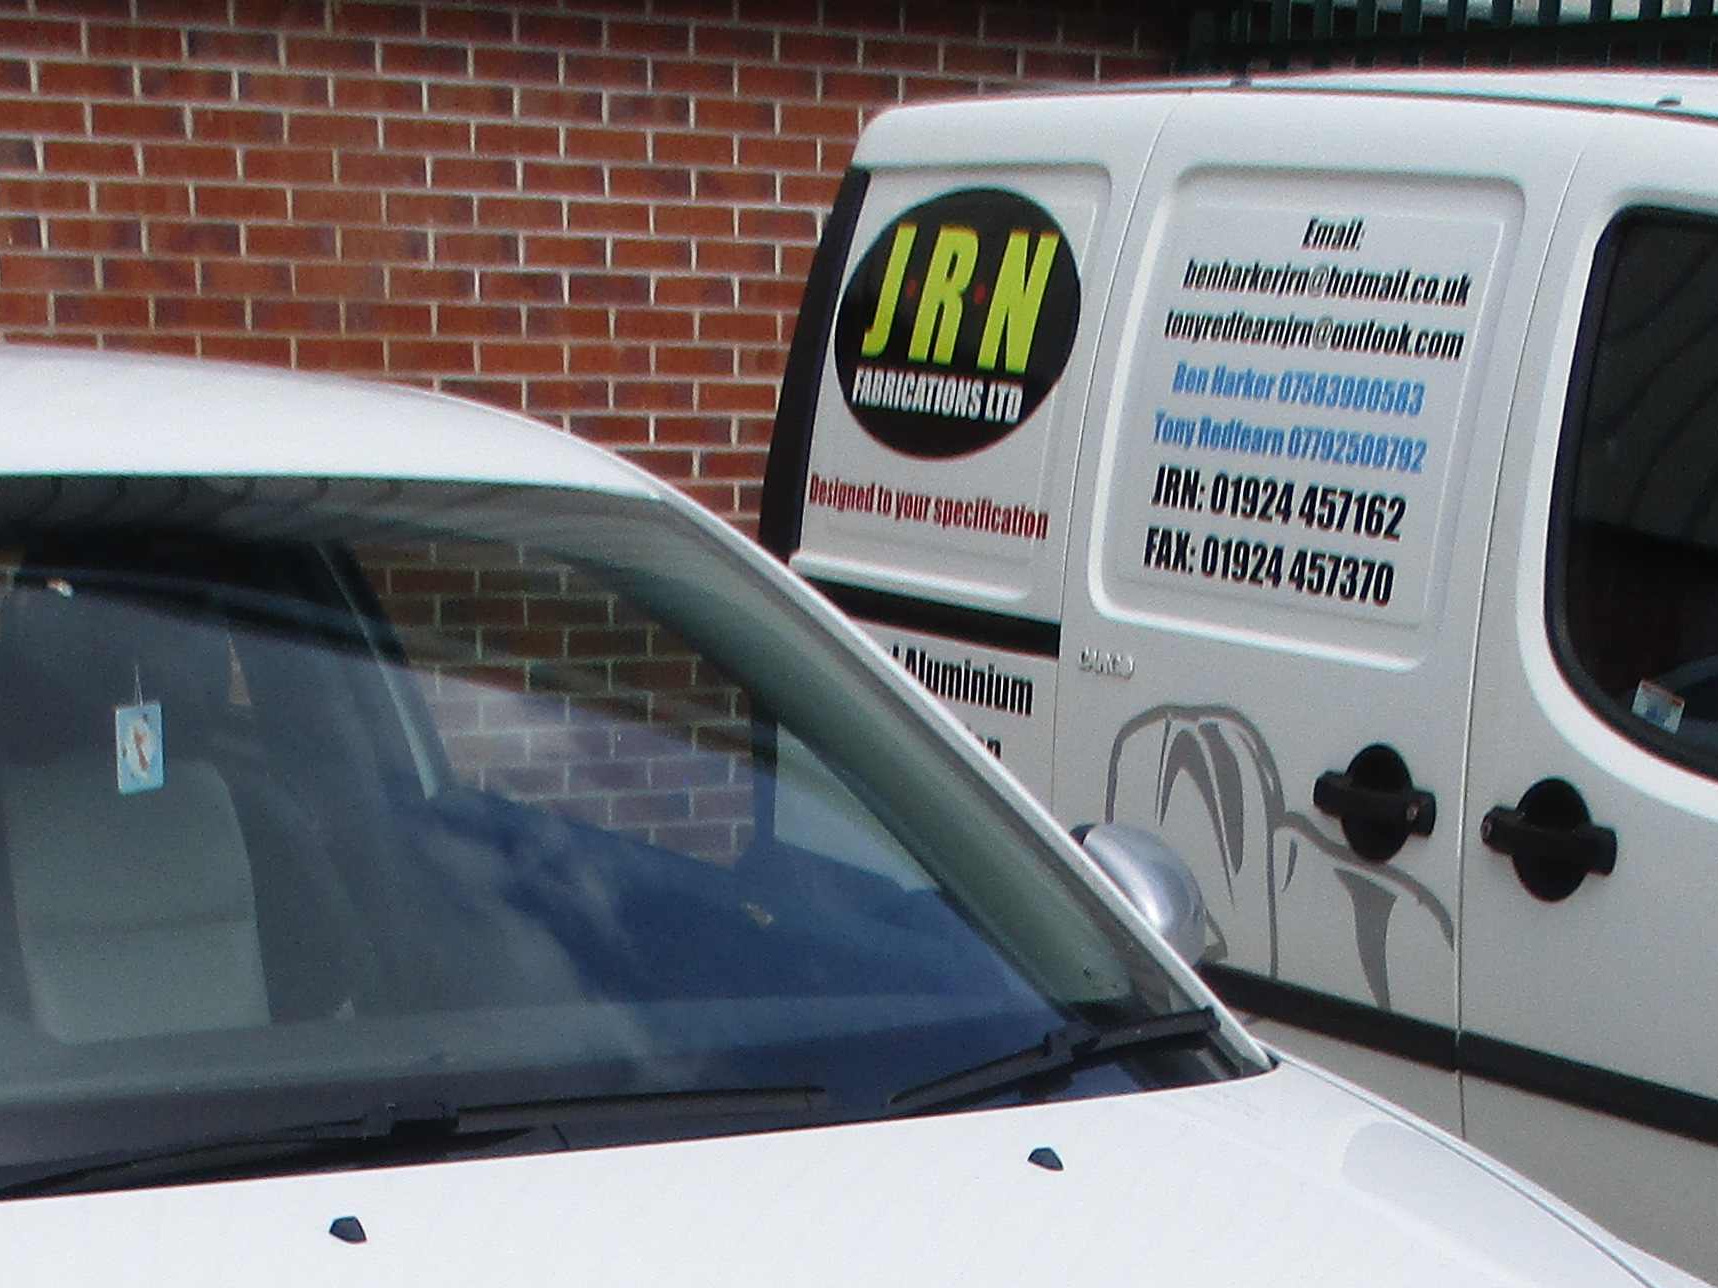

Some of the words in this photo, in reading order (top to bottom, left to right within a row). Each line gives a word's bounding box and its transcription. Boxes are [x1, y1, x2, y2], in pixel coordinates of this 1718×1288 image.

[1301, 216, 1366, 250] Email:
[1183, 258, 1471, 307] benharkerjrn@hotmail.co.uk
[1164, 309, 1465, 361] tonyredfearnjrn@outlook.com
[852, 365, 984, 420] FABRICATIONS
[984, 380, 1024, 424] LTD
[1172, 360, 1210, 394] Ben
[1211, 364, 1277, 400] Harker
[1154, 410, 1197, 448] Tony
[1198, 415, 1286, 456] Redfearn
[809, 473, 878, 513] Designed
[877, 485, 892, 519] to
[893, 489, 932, 522] your
[933, 497, 1049, 541] specification
[1151, 463, 1206, 512] JRN:
[1210, 470, 1296, 525] 01924
[1297, 481, 1408, 542] 457162
[1144, 524, 1197, 574] FAX:
[1200, 533, 1285, 589] 01924
[1286, 547, 1396, 606] 457370
[904, 645, 1034, 718] Aluminium
